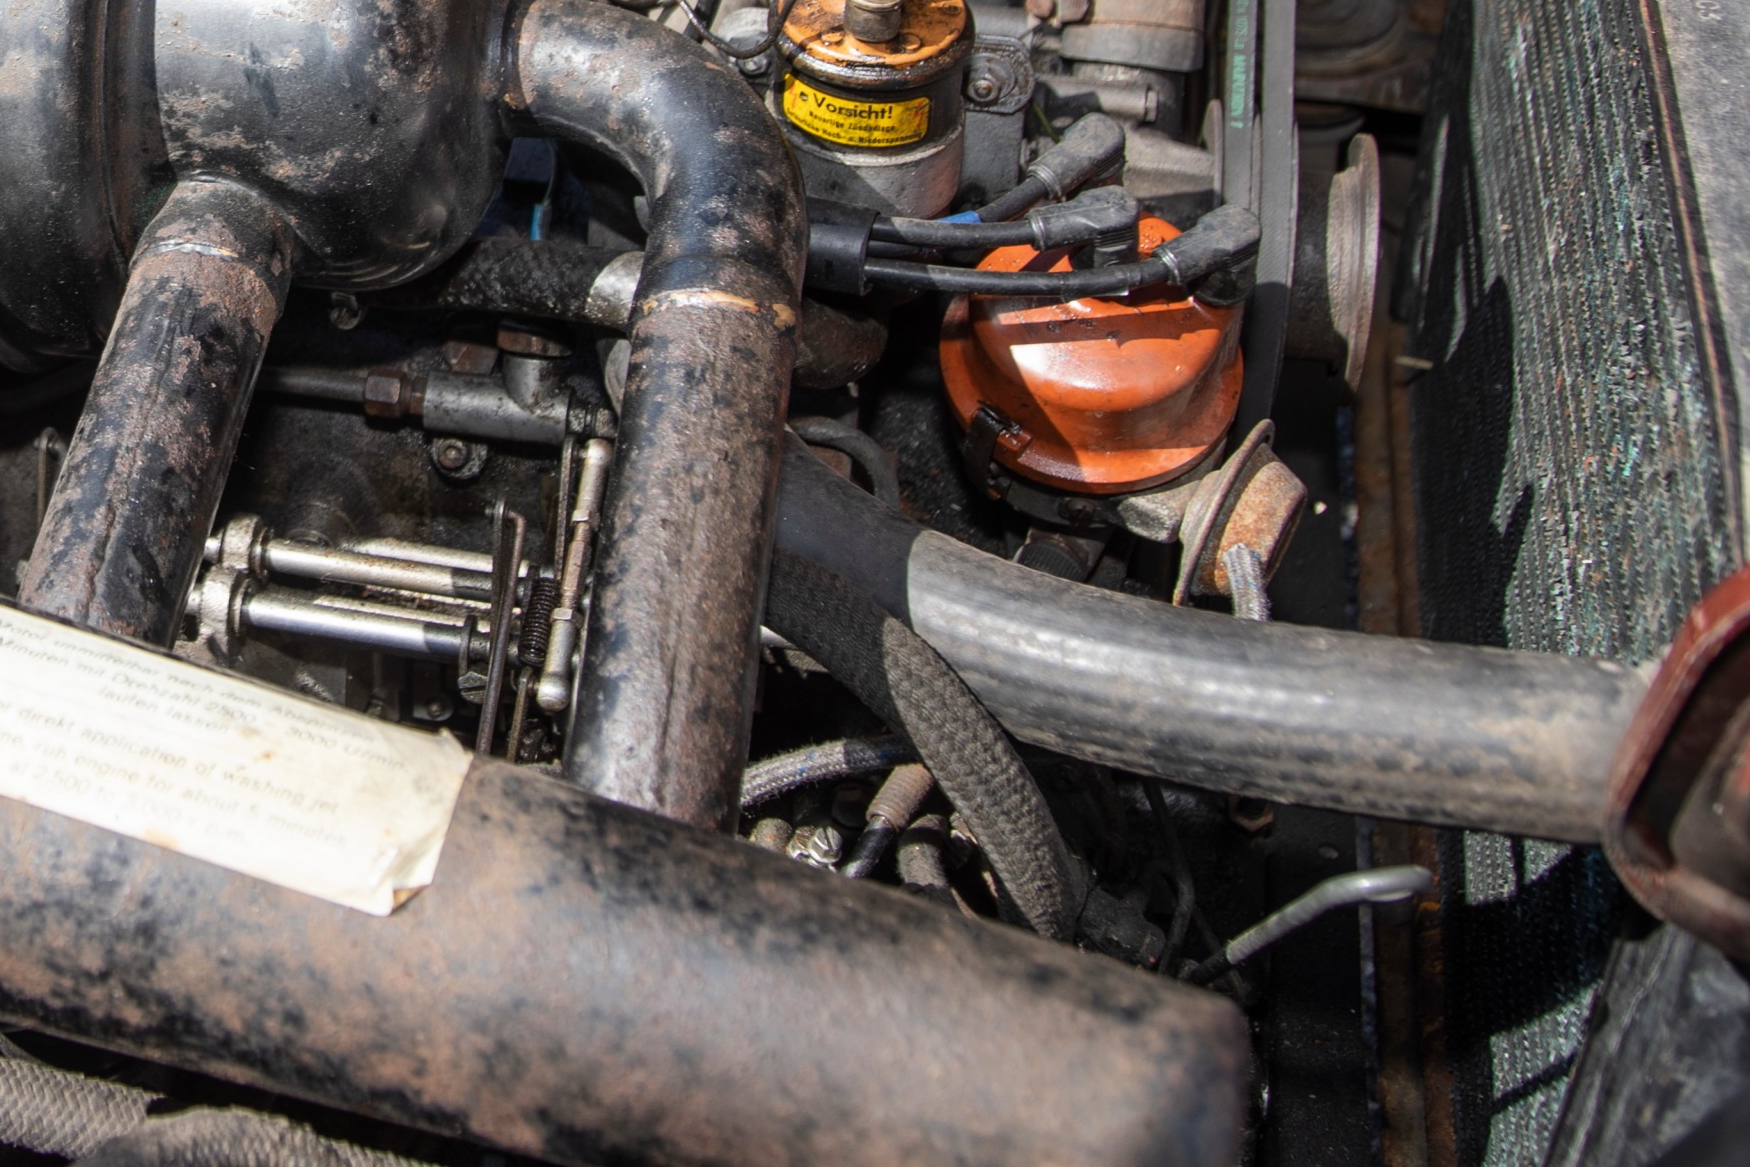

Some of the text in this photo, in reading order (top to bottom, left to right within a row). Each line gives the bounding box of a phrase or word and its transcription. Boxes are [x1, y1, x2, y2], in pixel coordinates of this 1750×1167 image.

[813, 92, 893, 120] Vorsicht!
[76, 662, 105, 677] mit
[113, 673, 199, 707] Drehzahl
[205, 702, 256, 724] 2500
[286, 727, 336, 749] 3000
[99, 686, 158, 712] laufen
[19, 704, 75, 733] direkt
[80, 724, 189, 770] application
[196, 760, 214, 776] of
[221, 769, 305, 810] washing
[309, 796, 339, 818] jet
[36, 741, 68, 760] run
[73, 754, 140, 787] engine
[148, 775, 174, 794] for
[183, 786, 239, 814] about
[247, 804, 259, 819] 5
[268, 813, 347, 849] minutes
